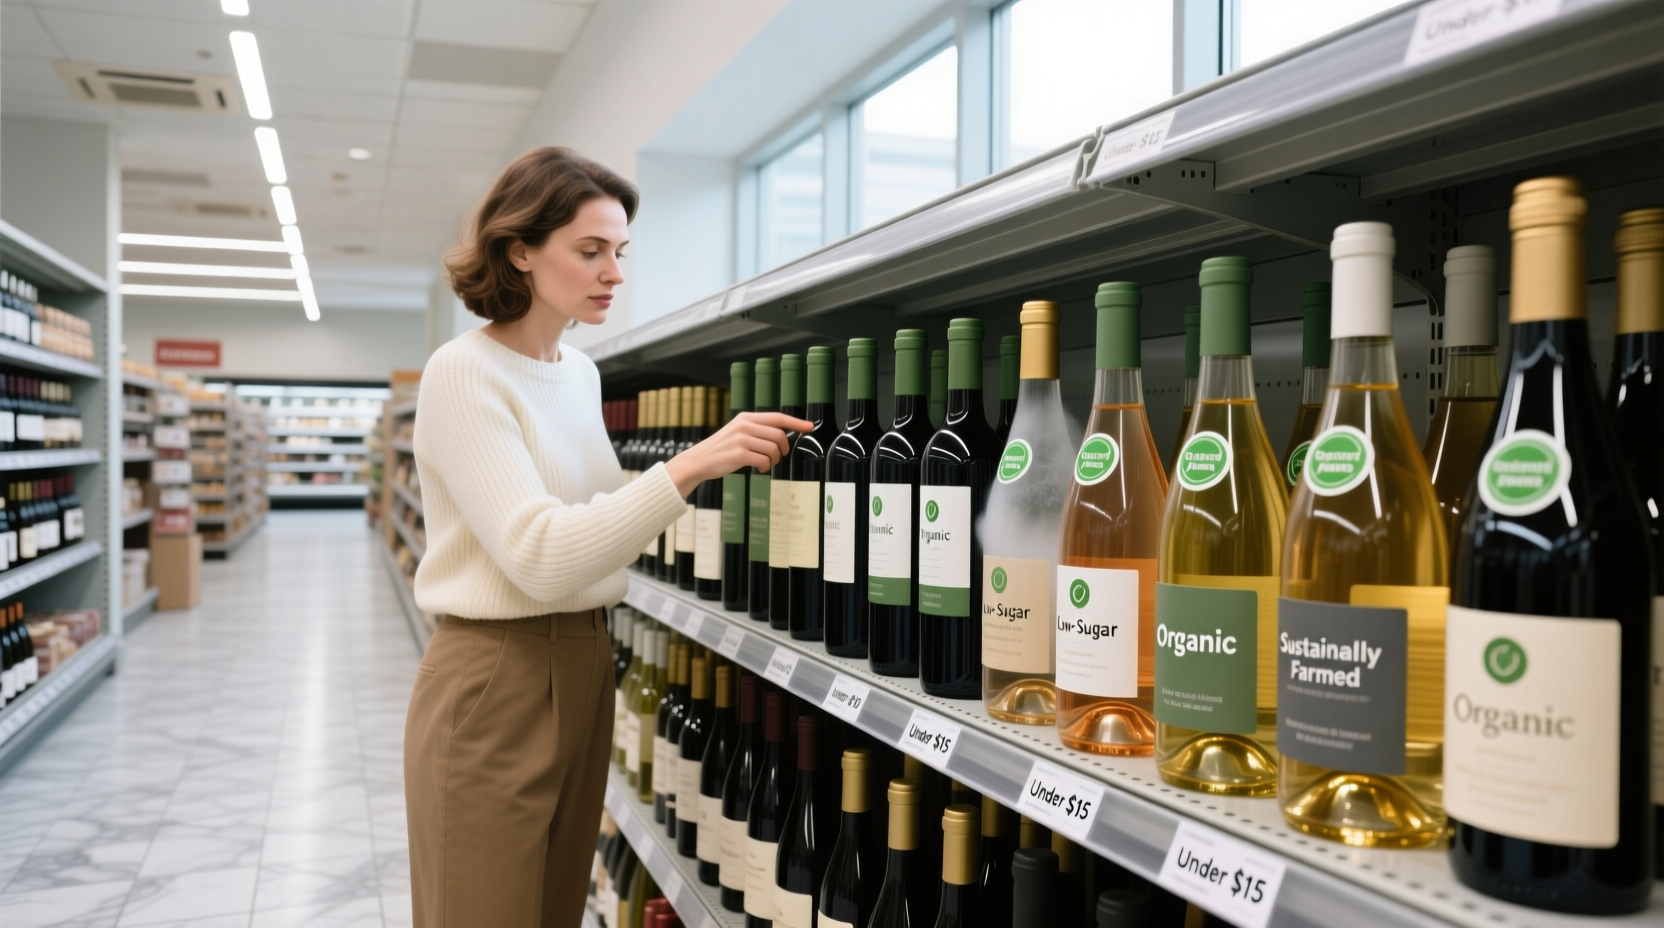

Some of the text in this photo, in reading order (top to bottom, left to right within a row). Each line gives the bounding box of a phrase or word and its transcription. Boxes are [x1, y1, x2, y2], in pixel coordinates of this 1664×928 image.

[1156, 623, 1237, 657] Organic
[1279, 632, 1382, 669] Sustainally
[1290, 660, 1361, 688] Farmed
[1453, 692, 1576, 740] Organic
[933, 733, 951, 753] $15
[1029, 778, 1092, 820] Under $15
[1177, 846, 1267, 903] Under $15
